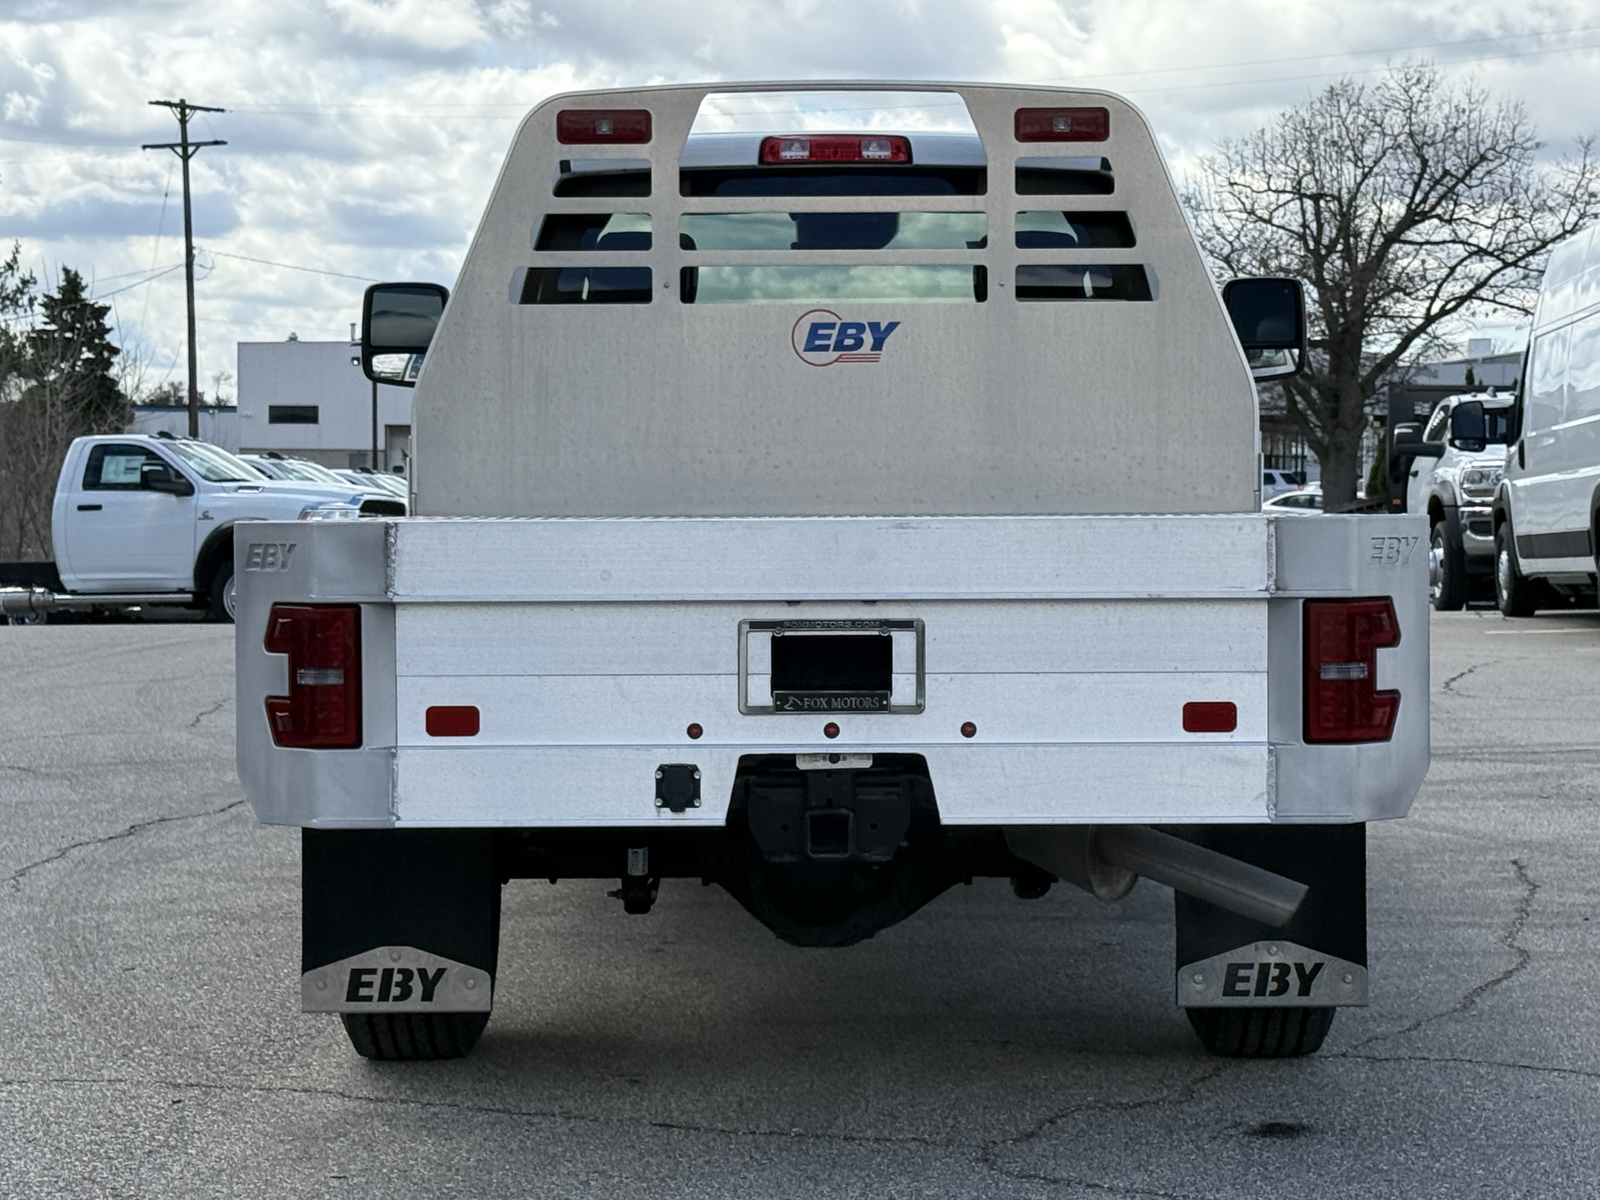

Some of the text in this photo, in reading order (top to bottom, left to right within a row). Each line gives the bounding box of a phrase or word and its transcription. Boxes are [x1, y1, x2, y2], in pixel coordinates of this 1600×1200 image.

[803, 321, 901, 352] EBY
[245, 543, 297, 571] EBY
[1369, 536, 1419, 565] EBY
[803, 697, 880, 709] FOX MOTORS
[345, 967, 448, 1003] EBY
[1222, 962, 1325, 997] EBY
